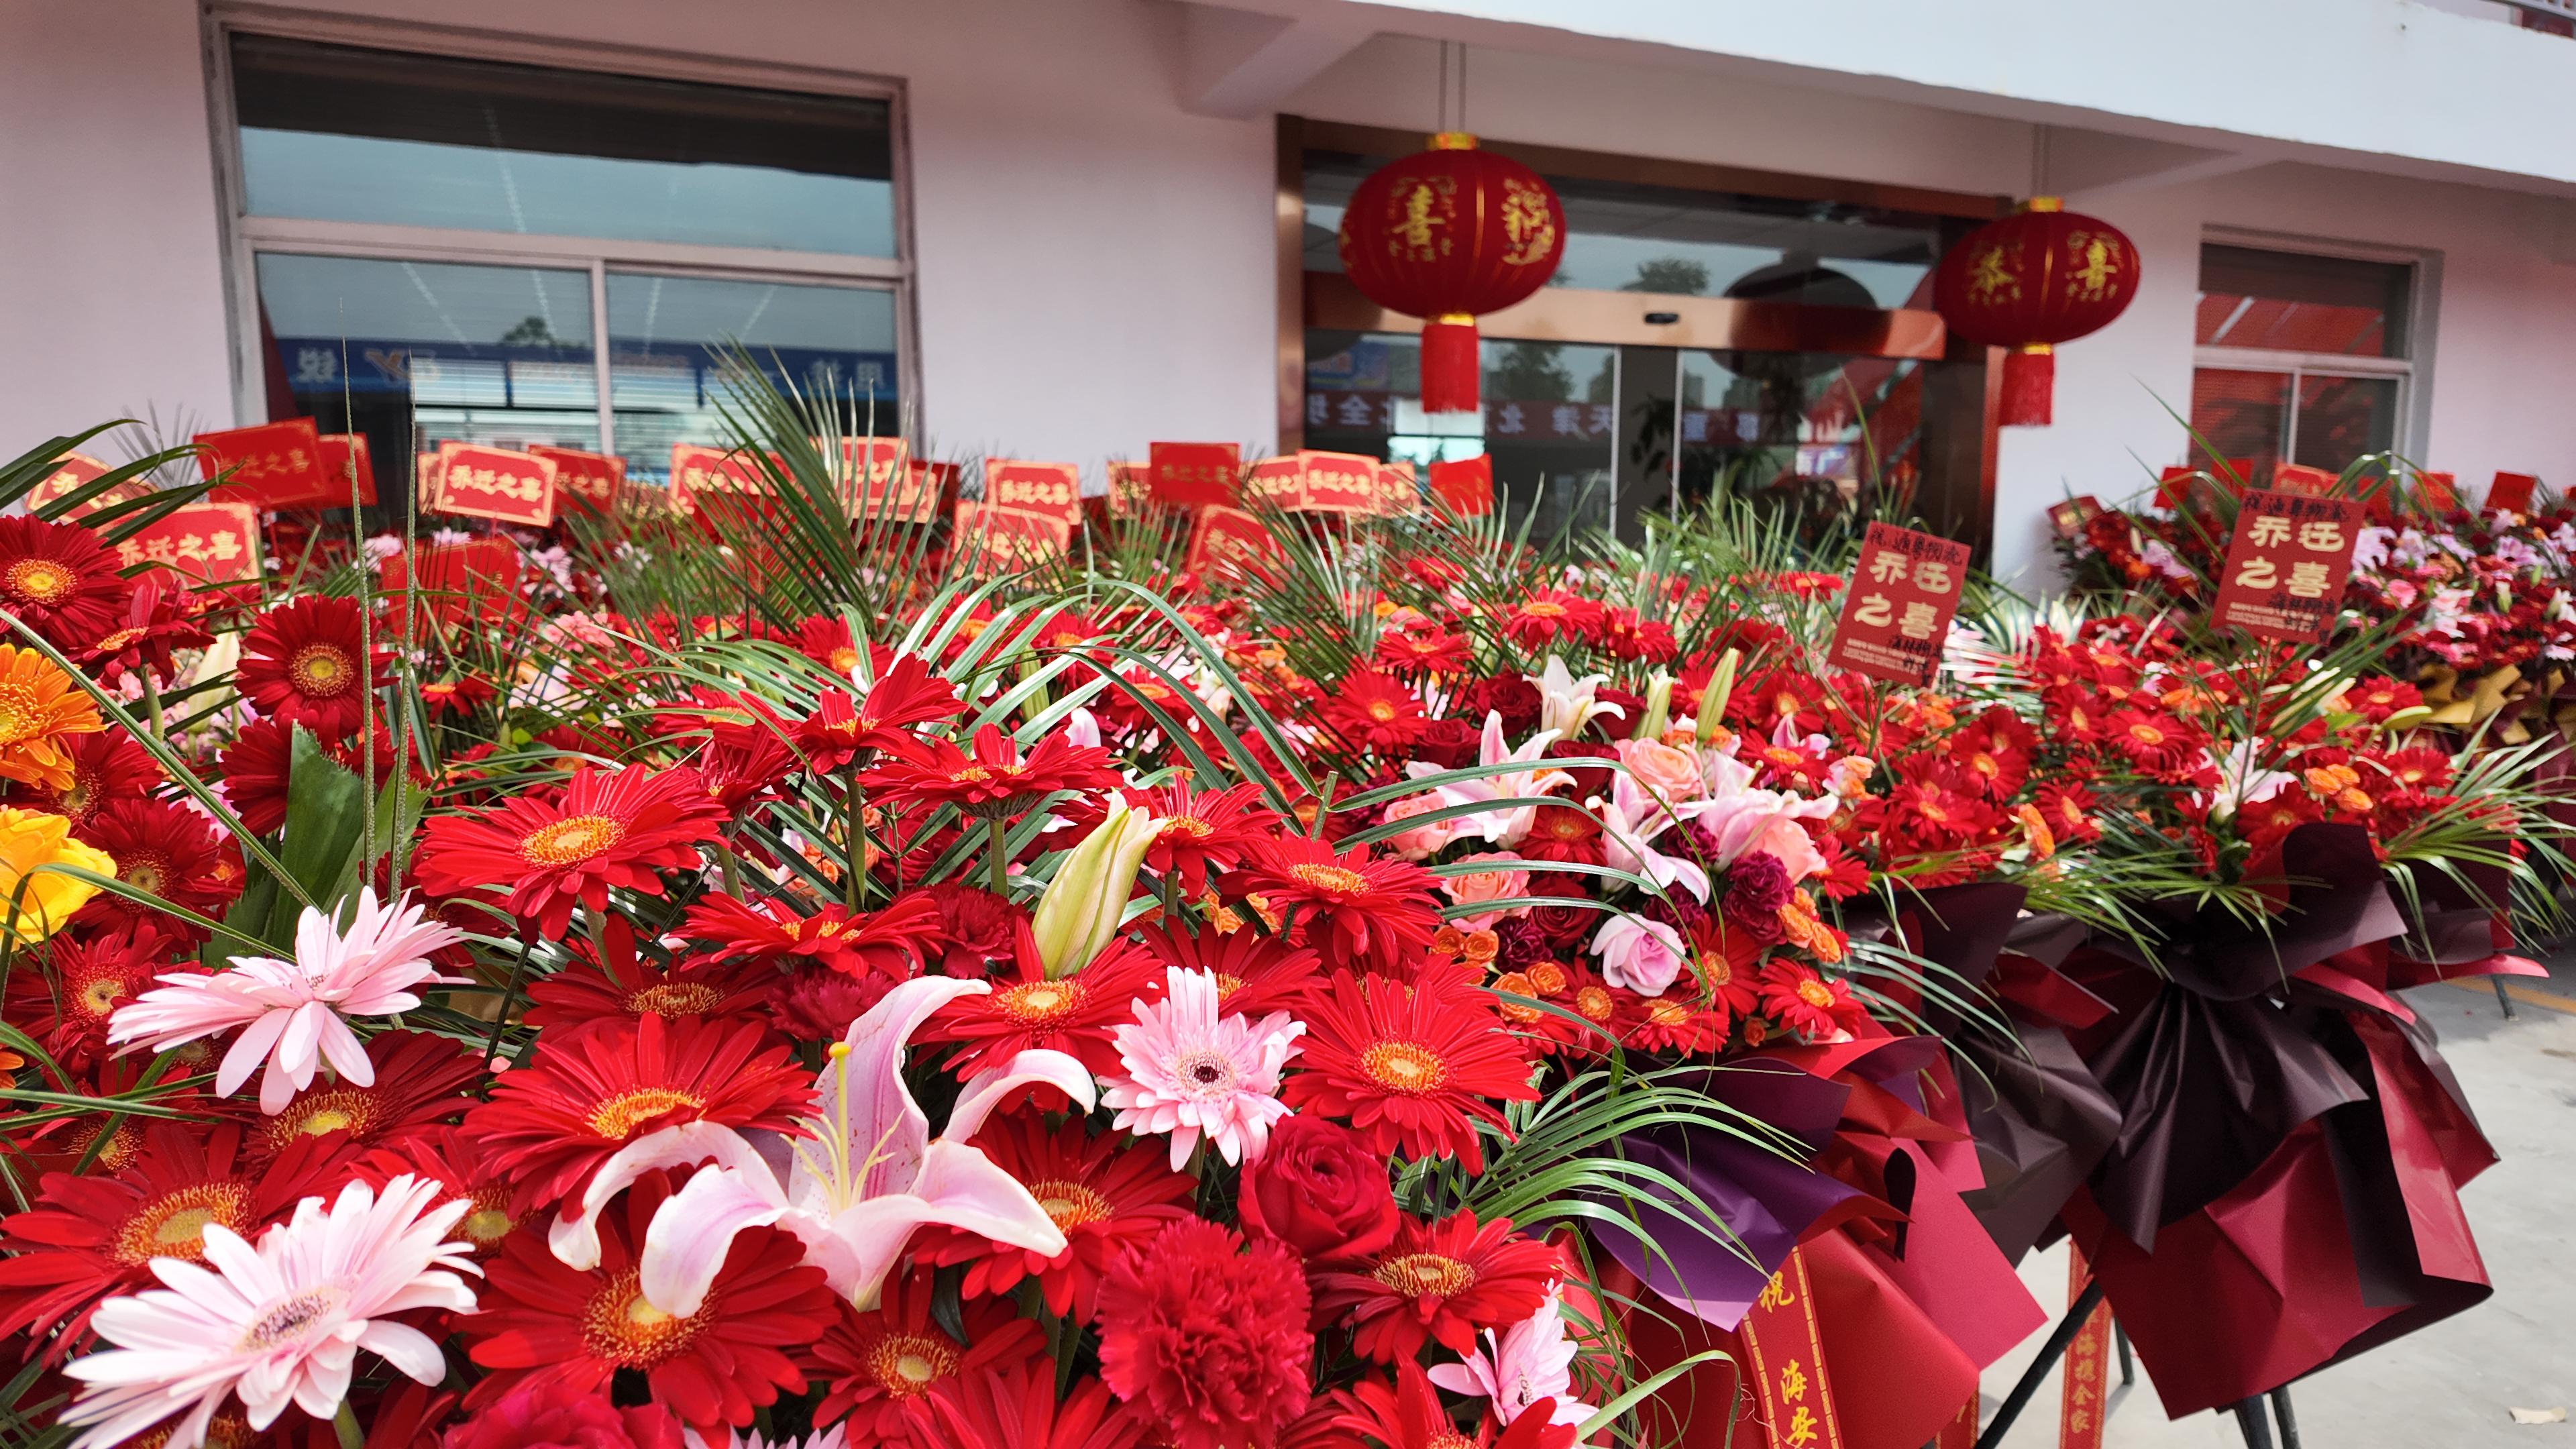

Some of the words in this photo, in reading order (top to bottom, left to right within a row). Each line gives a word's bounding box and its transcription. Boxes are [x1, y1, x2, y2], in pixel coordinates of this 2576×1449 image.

[448, 465, 543, 502] 乔迁之喜
[2247, 515, 2345, 553] 乔迁
[1869, 551, 1951, 594] 乔迁
[2235, 555, 2332, 598] 之喜
[1854, 592, 1938, 639] 之喜
